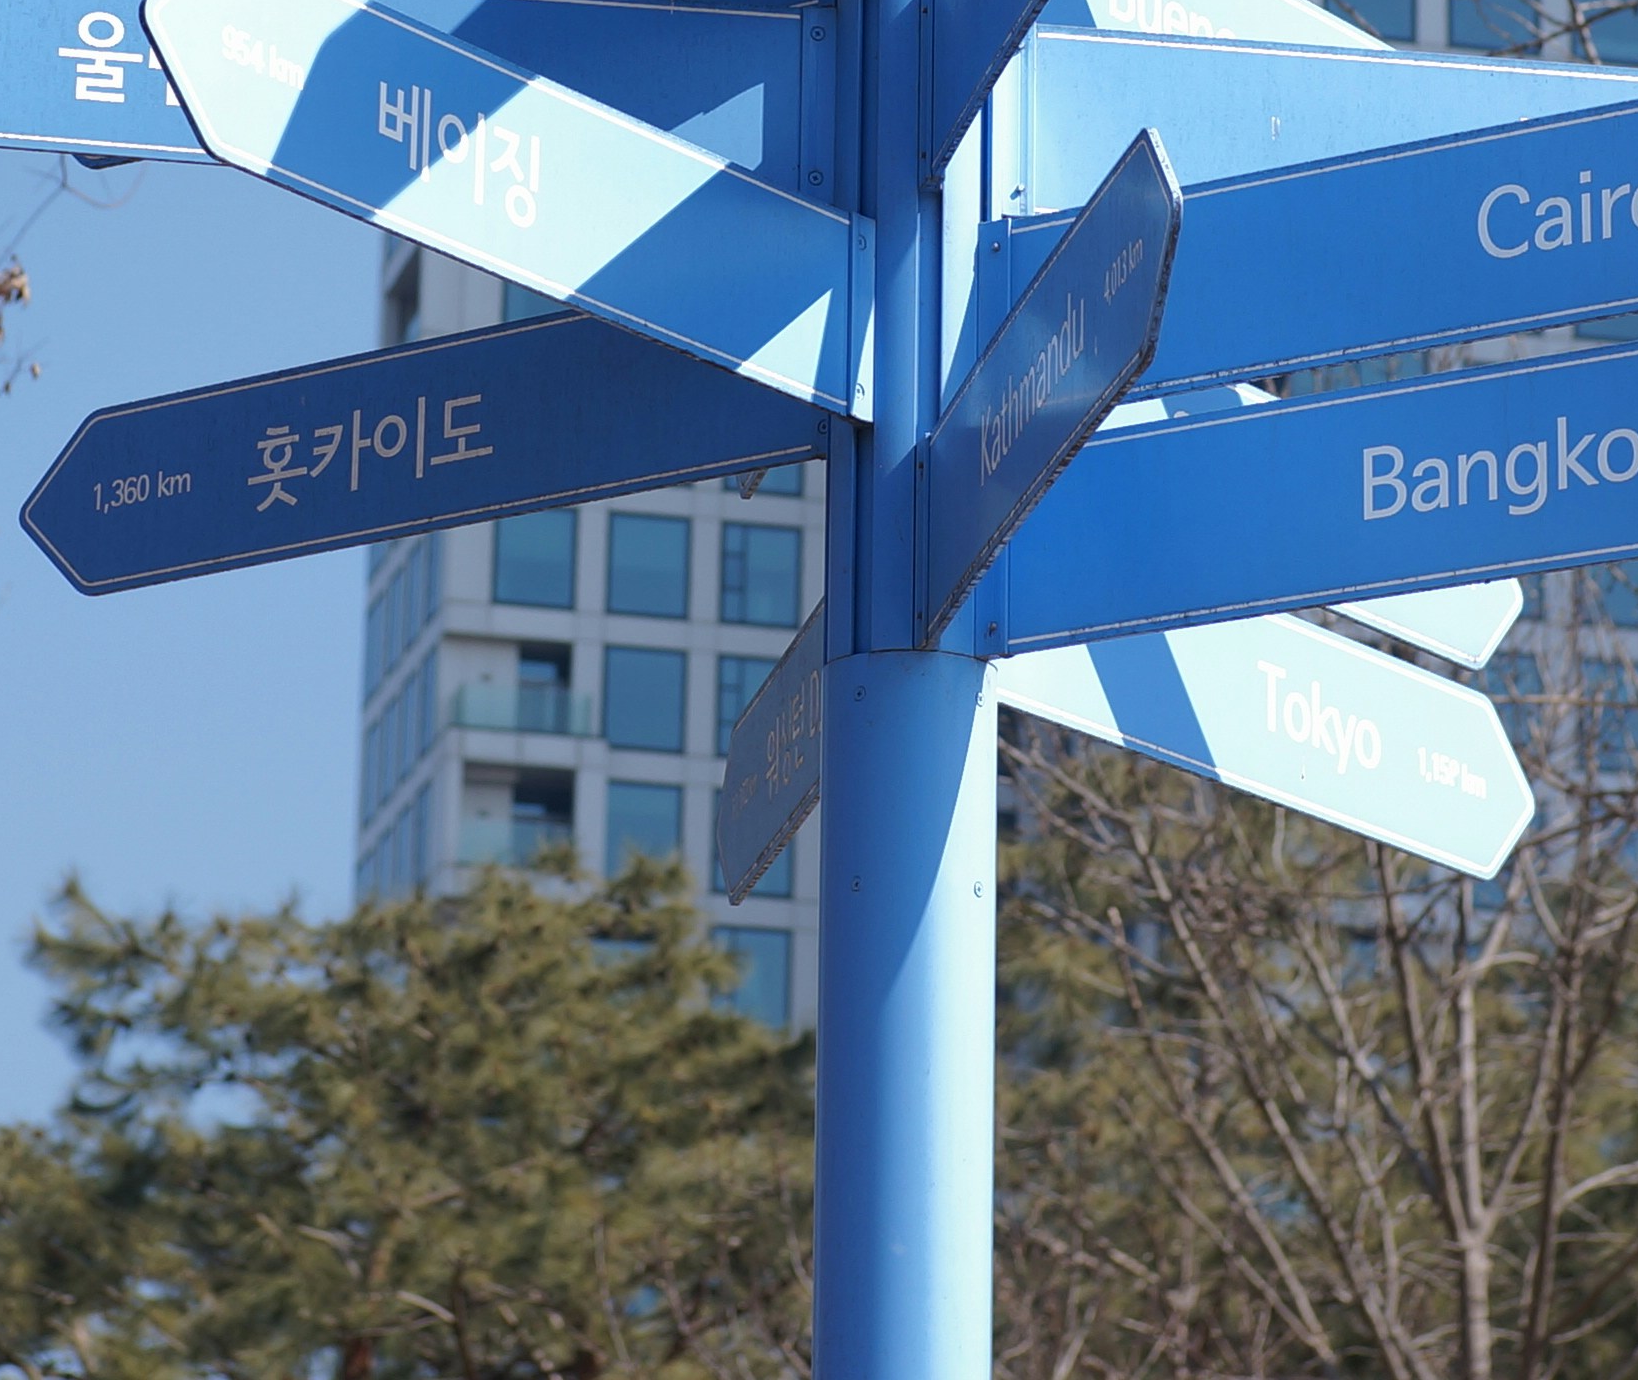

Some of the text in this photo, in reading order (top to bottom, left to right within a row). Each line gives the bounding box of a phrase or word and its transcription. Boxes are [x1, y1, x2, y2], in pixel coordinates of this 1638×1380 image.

[221, 25, 540, 228] 954 km 베이징
[980, 238, 1143, 487] Kathmandu 4,013 km
[93, 394, 493, 514] 1,360 km 홋카이도
[1257, 659, 1382, 774] Tokyo
[1460, 762, 1488, 800] km
